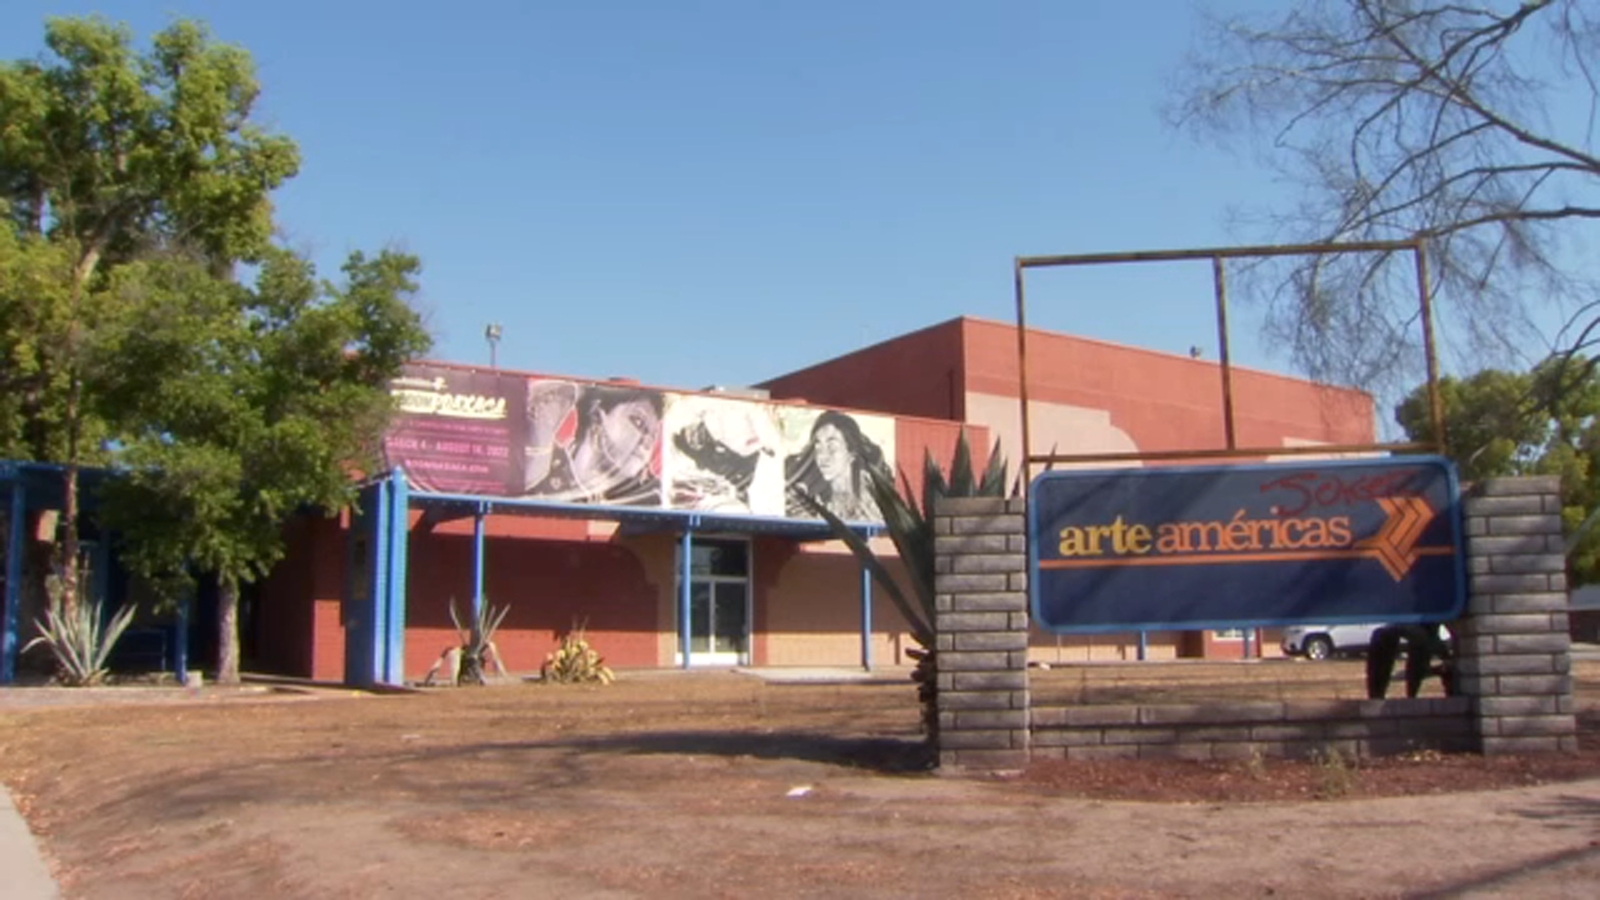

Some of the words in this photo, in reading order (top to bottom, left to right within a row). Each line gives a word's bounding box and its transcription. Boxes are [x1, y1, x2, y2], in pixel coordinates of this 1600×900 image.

[435, 441, 471, 453] AUGUST
[1058, 514, 1152, 557] arte
[1156, 506, 1352, 553] américas
